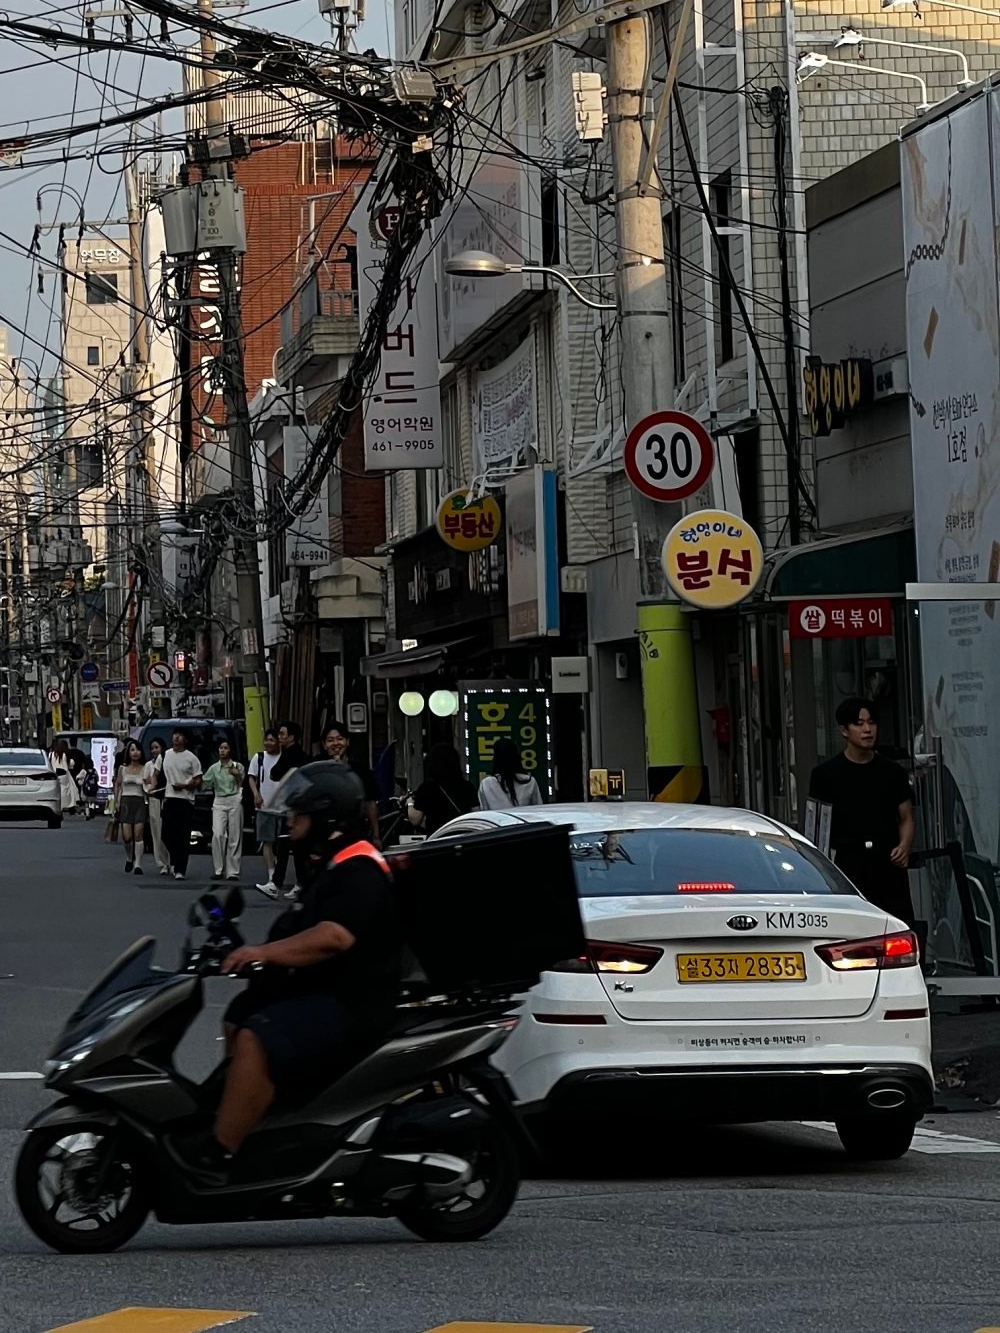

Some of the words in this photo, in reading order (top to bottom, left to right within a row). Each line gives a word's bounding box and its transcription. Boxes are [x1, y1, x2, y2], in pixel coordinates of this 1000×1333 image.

[81, 249, 121, 264] 연무장
[371, 417, 434, 434] 영어학원
[372, 439, 434, 452] 461-9905
[646, 431, 693, 480] 30
[444, 512, 494, 540] 부동산
[680, 522, 742, 543] 현영이네
[677, 549, 752, 590] 분식
[804, 609, 821, 630] 쌀
[831, 608, 883, 629] 떡볶이
[766, 912, 828, 929] KM3035
[745, 956, 796, 977] 2835
